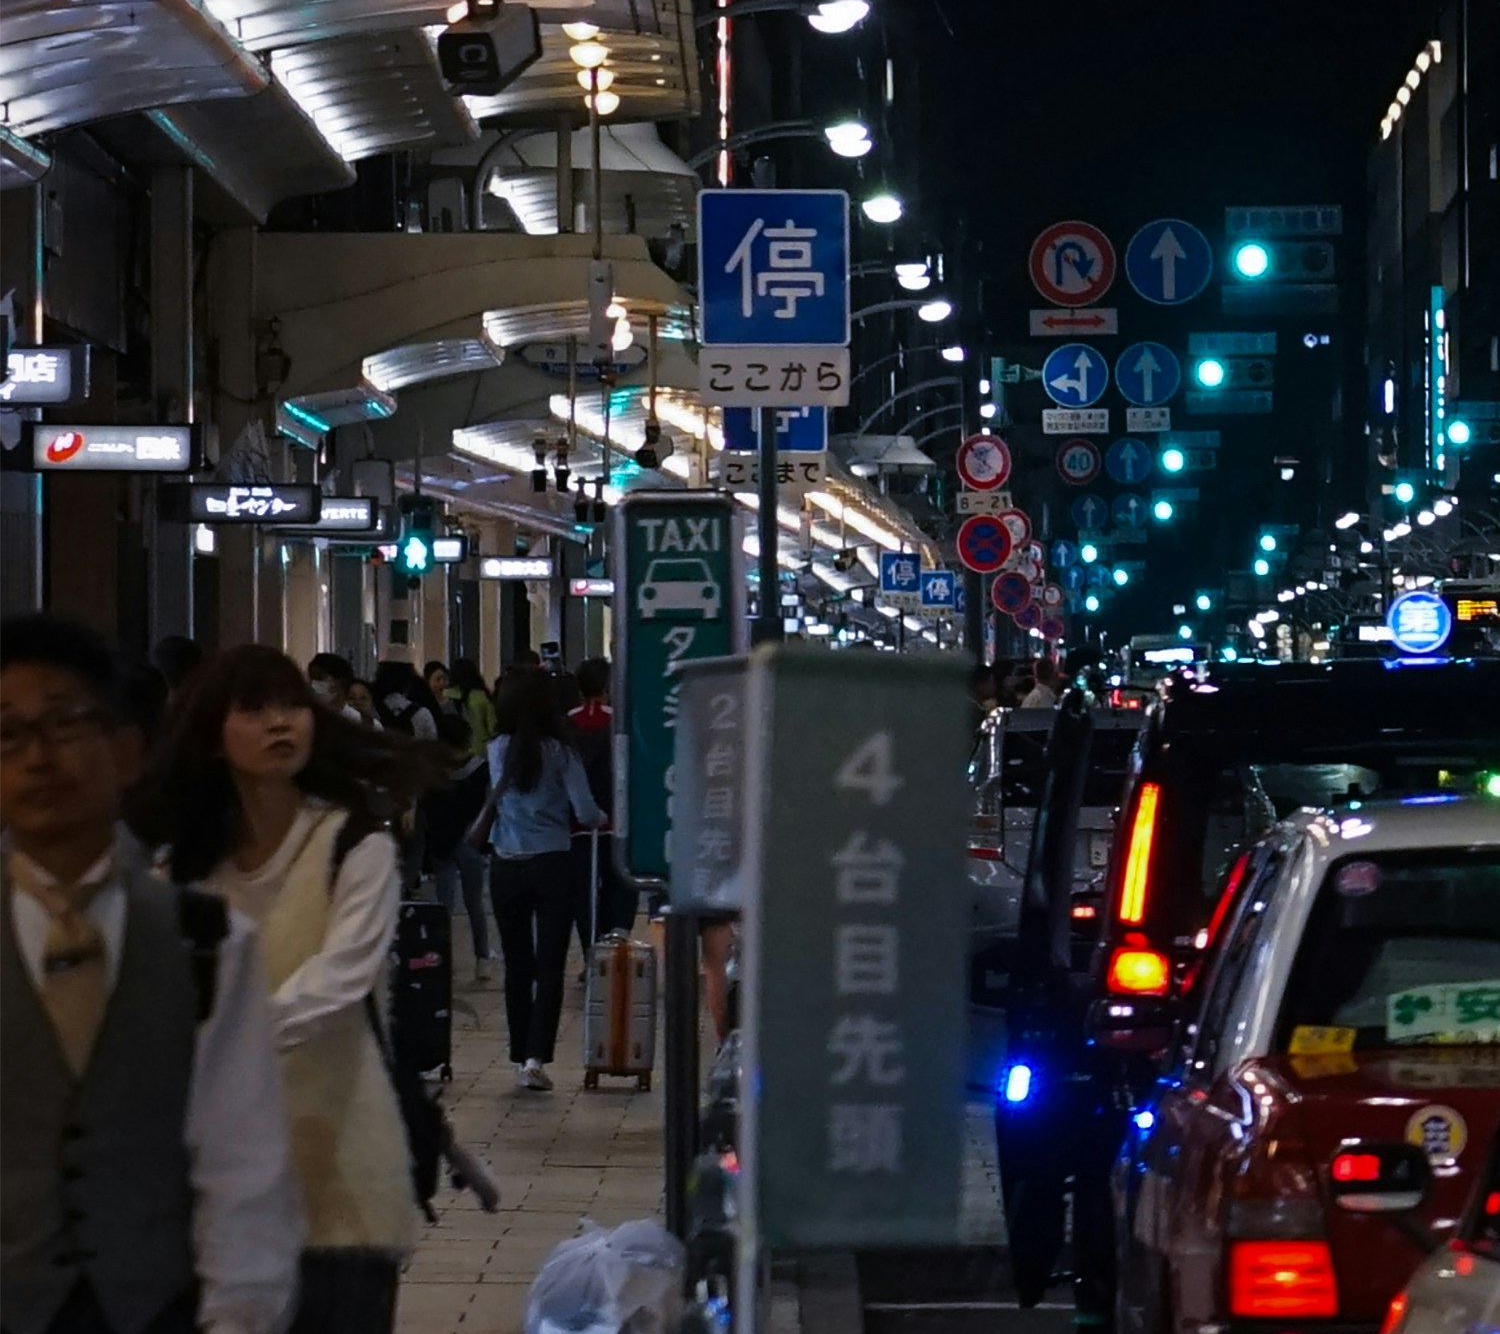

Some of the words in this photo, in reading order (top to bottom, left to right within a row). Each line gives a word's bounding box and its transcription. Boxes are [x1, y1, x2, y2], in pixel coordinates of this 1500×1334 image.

[724, 218, 825, 319] 停
[709, 361, 841, 393] ここから
[1068, 452, 1090, 471] 40
[637, 518, 719, 552] TAXI
[887, 558, 917, 586] 停
[925, 576, 951, 601] 停
